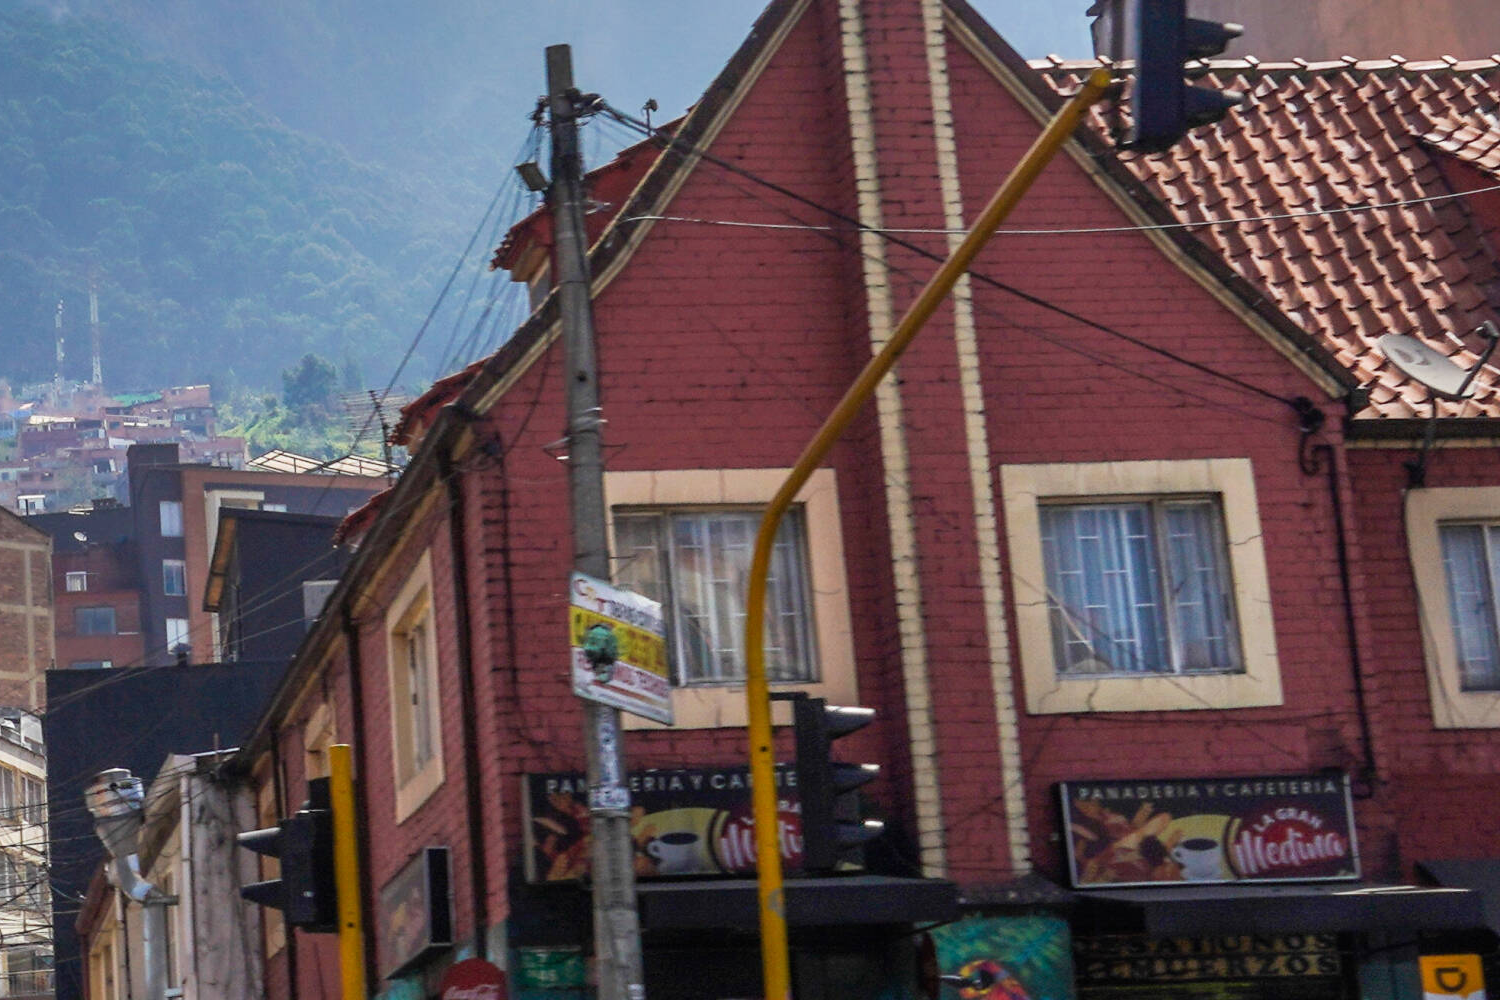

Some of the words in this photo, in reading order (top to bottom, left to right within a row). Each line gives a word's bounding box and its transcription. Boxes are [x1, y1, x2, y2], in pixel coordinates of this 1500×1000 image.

[546, 776, 684, 794] PANERIA
[690, 775, 702, 790] Y
[1078, 781, 1199, 800] PANADERIA
[1205, 782, 1217, 797] Y
[1223, 779, 1338, 797] CAFETERIA
[1252, 813, 1276, 832] LA
[1274, 807, 1323, 829] GRAN
[1233, 827, 1346, 875] Medina
